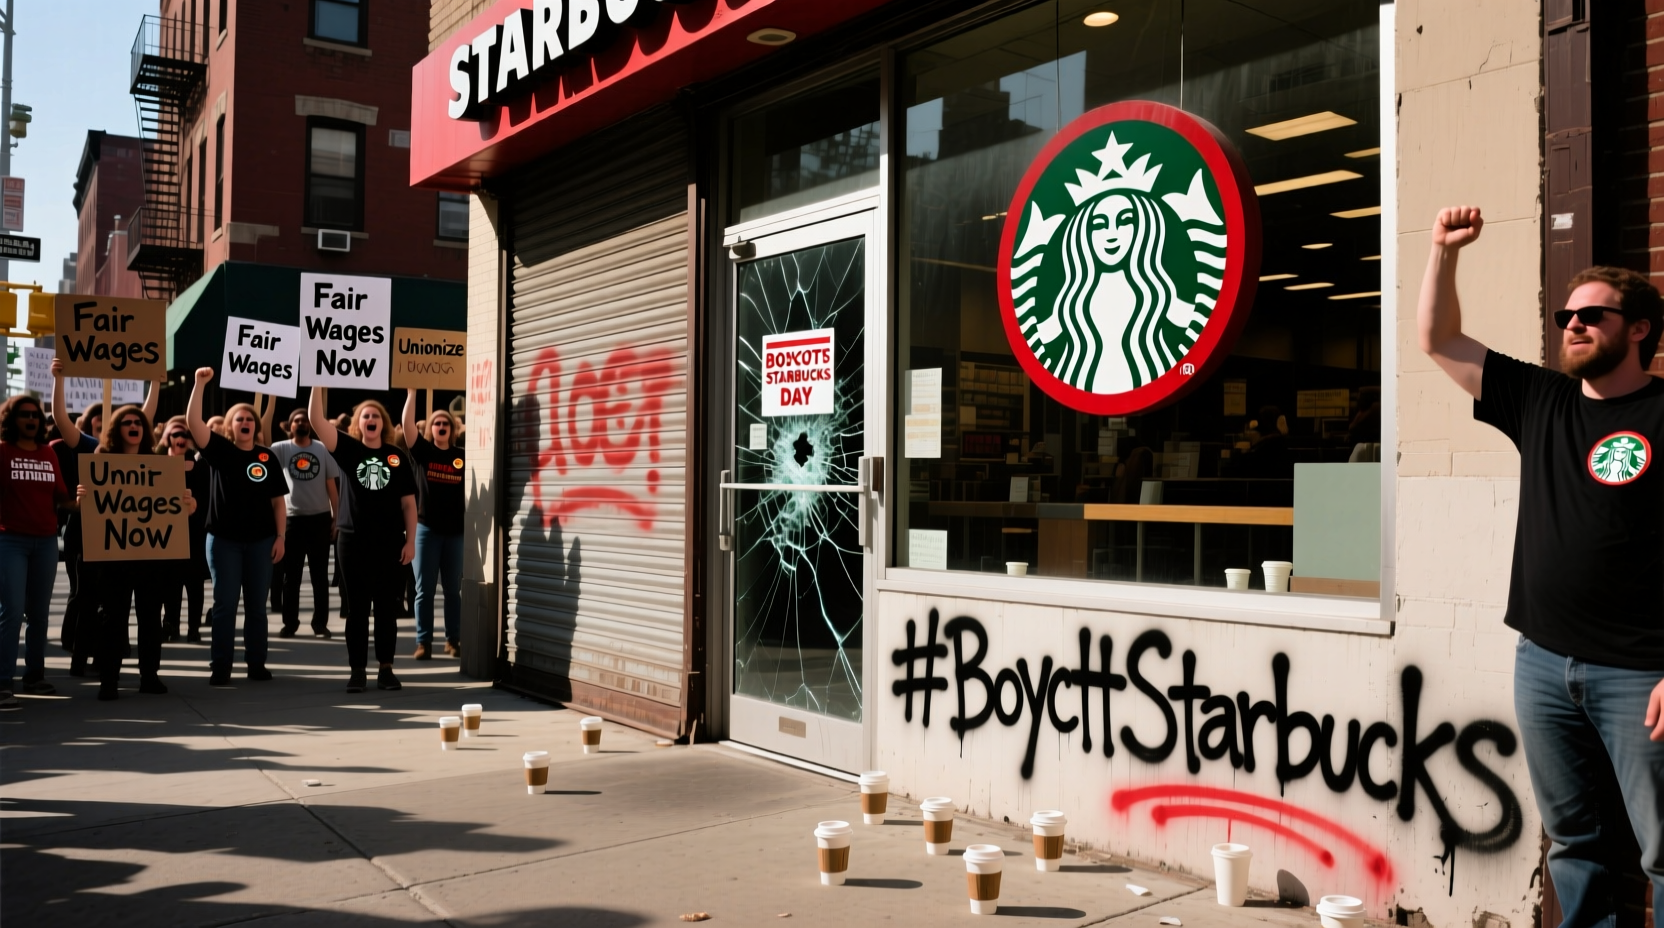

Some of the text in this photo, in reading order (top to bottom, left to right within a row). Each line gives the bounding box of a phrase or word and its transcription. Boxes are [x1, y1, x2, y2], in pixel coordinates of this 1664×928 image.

[315, 282, 368, 311] Fair
[73, 301, 135, 332] Fair
[237, 323, 282, 351] Fair
[305, 315, 385, 352] Wages
[399, 338, 464, 356] Unionize
[62, 334, 160, 372] Wages
[228, 351, 293, 385] Wages
[316, 349, 377, 378] Now
[766, 368, 832, 385] STARBUCKS
[780, 386, 813, 407] DAY
[94, 488, 182, 524] Wages
[104, 518, 173, 551] Now
